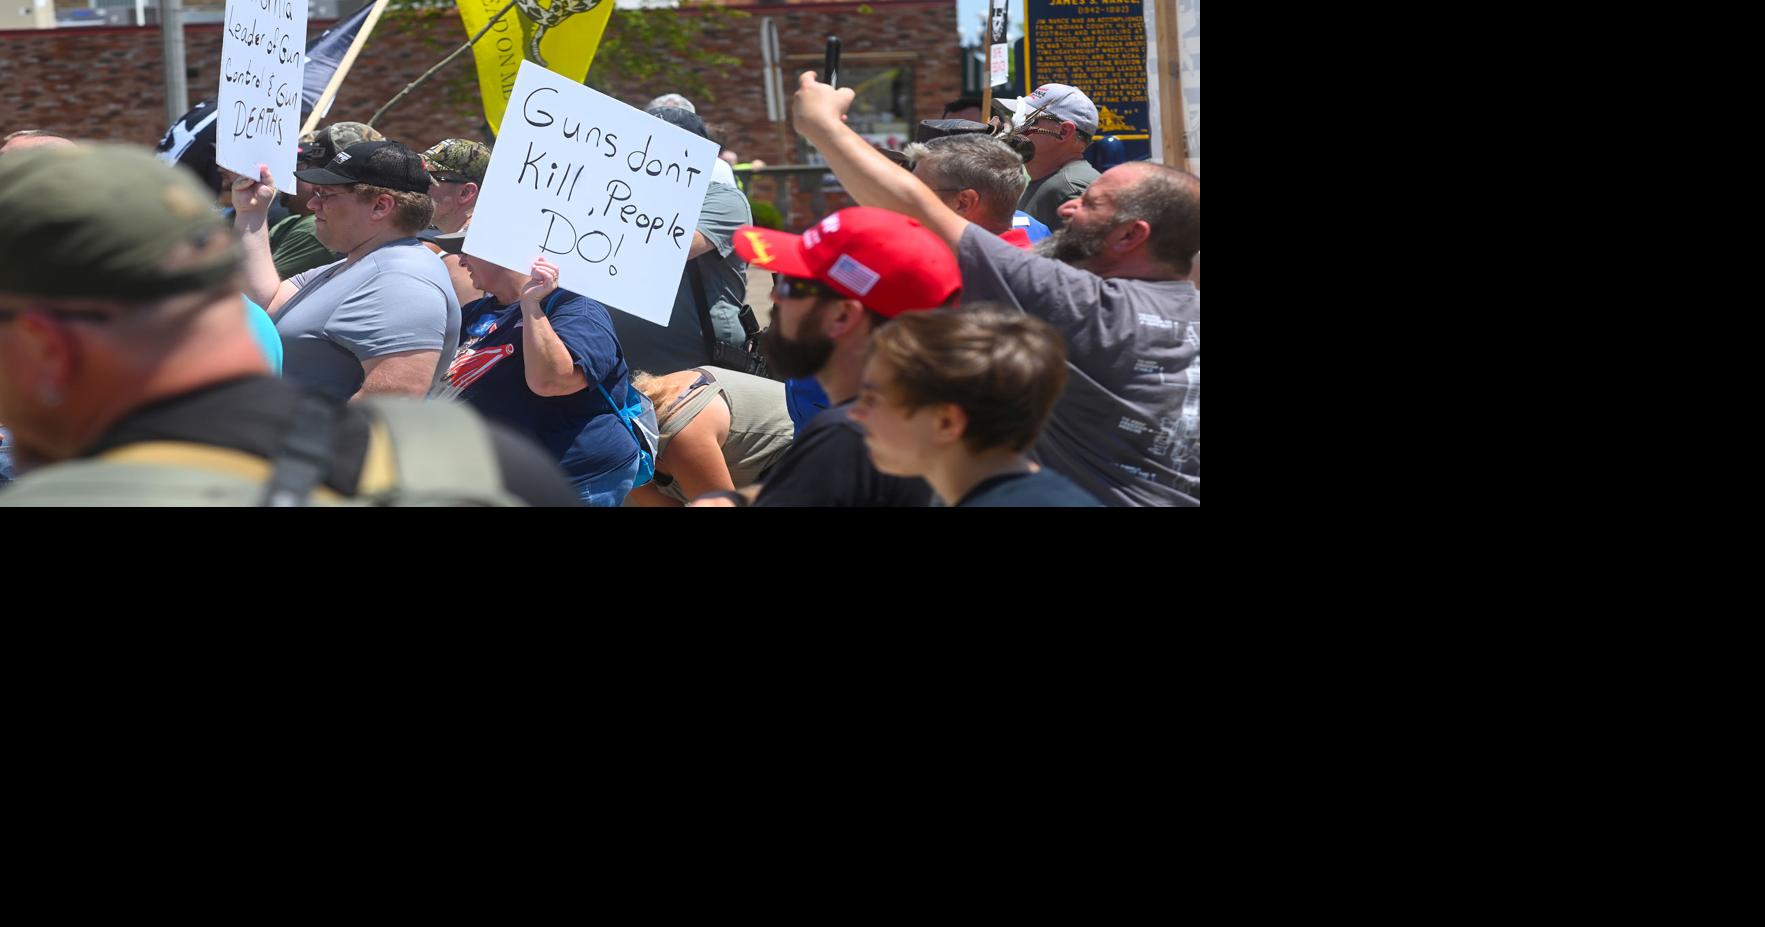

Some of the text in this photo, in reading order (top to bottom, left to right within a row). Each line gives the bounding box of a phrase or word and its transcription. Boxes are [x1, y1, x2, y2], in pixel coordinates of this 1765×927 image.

[228, 5, 300, 69] Leader of Gun
[225, 57, 264, 88] Control
[275, 83, 298, 110] Gun
[523, 87, 618, 158] Guns
[538, 208, 624, 276] DO!
